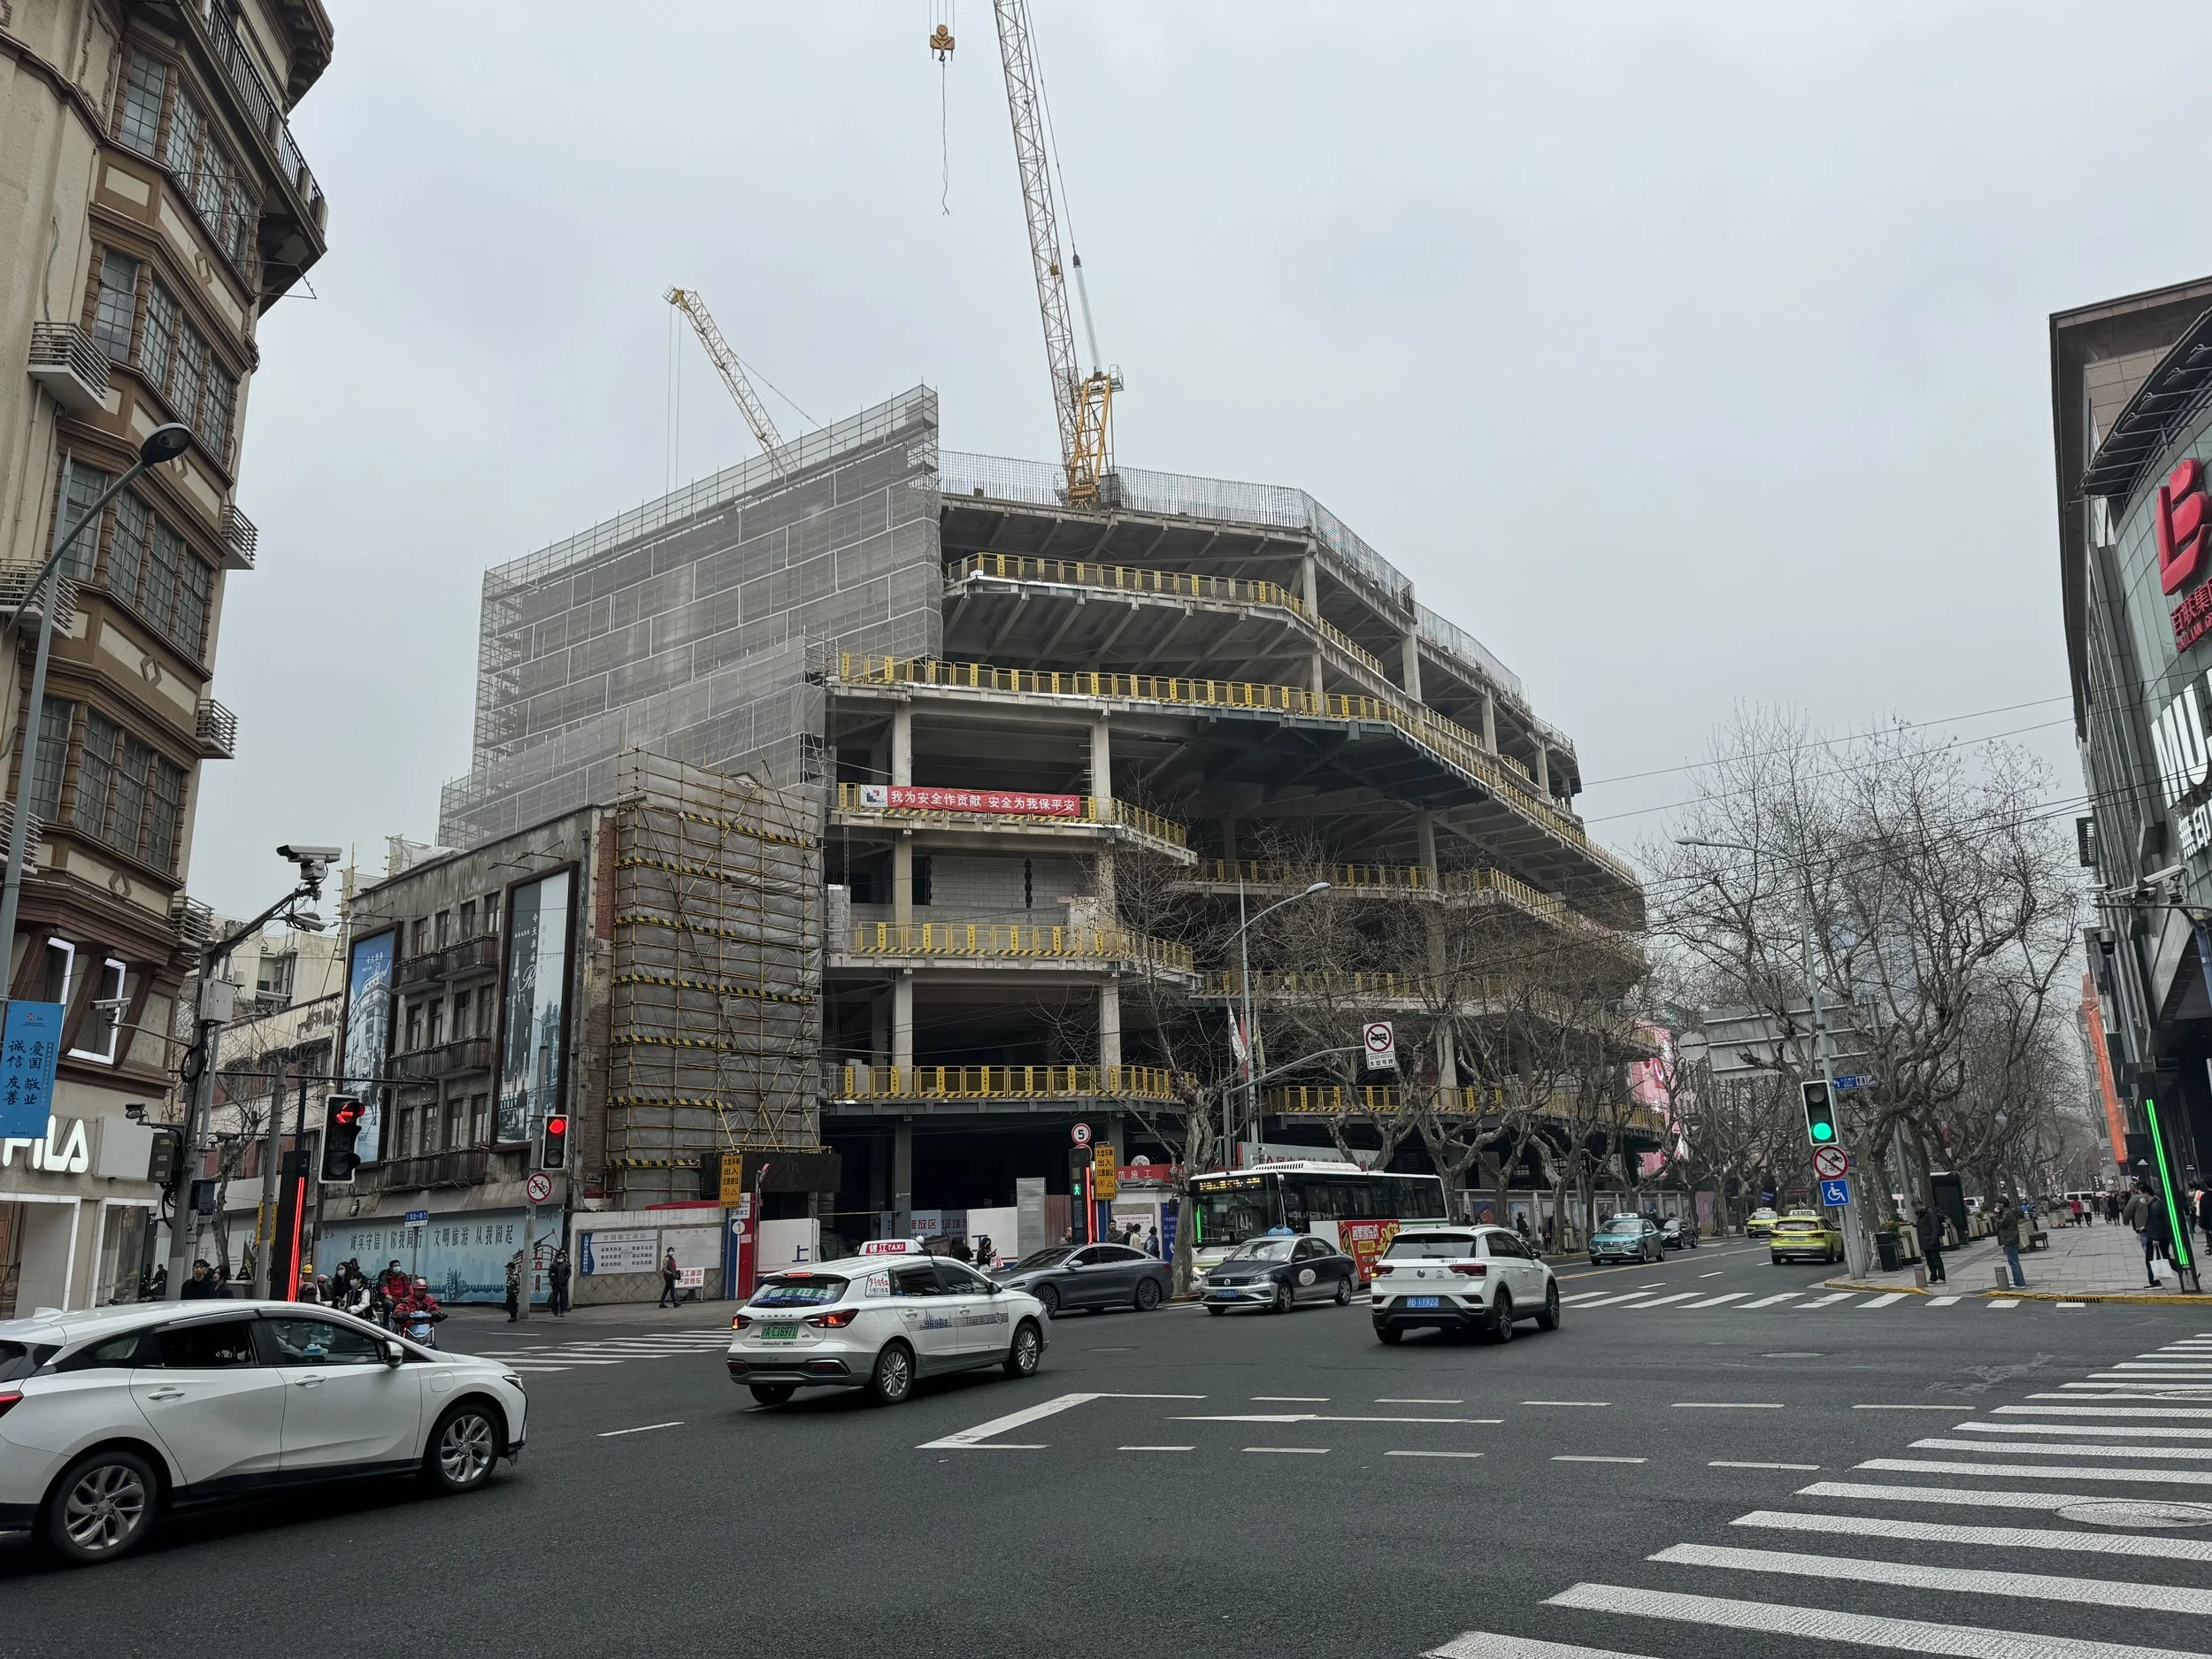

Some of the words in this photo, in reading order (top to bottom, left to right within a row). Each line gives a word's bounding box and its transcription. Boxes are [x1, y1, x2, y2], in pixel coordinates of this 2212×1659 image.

[890, 790, 982, 807] 我为安全作贡献
[987, 796, 1075, 811] 安全为我保平安
[2178, 799, 2212, 861] 無印
[6, 1040, 27, 1069] 诚信
[29, 1041, 44, 1070] 爱国
[3, 1075, 20, 1106] 友善
[23, 1077, 41, 1105] 敬业
[1078, 1129, 1085, 1140] 5
[434, 1226, 469, 1248] 文明旅游
[475, 1224, 513, 1246] 从我做起
